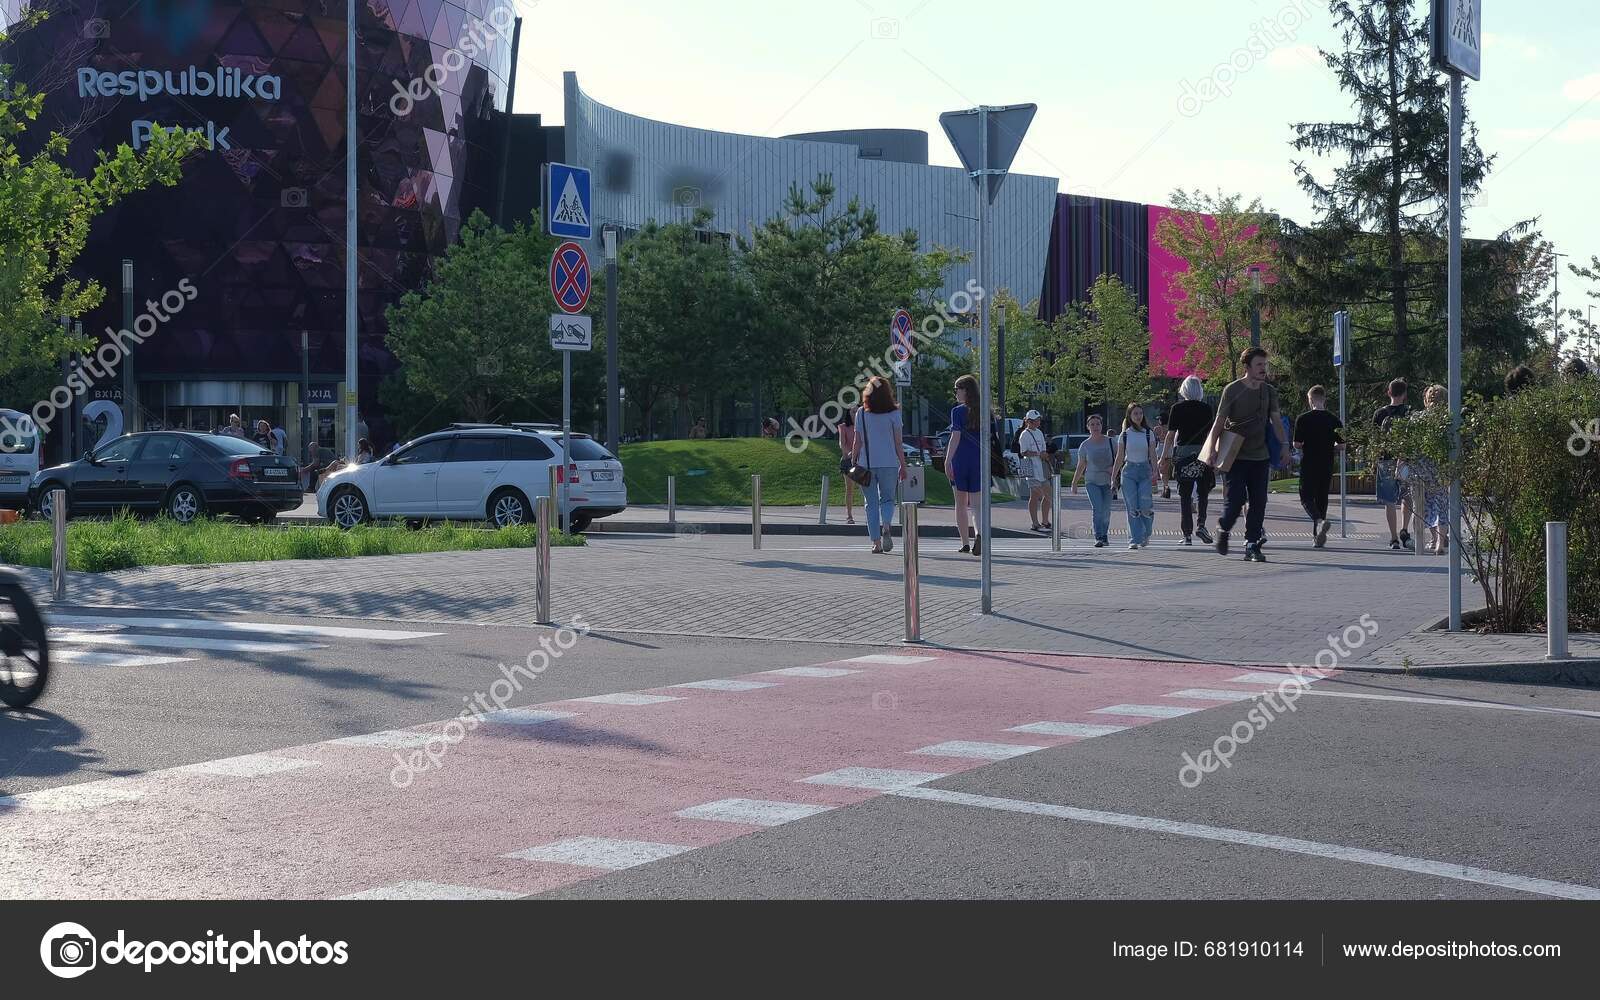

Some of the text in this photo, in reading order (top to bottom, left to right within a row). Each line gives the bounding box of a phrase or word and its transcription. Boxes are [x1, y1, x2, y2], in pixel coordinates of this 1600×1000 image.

[77, 65, 281, 102] Respublika
[131, 120, 231, 151] Pk
[95, 389, 122, 400] ВХІД
[82, 400, 124, 452] 2
